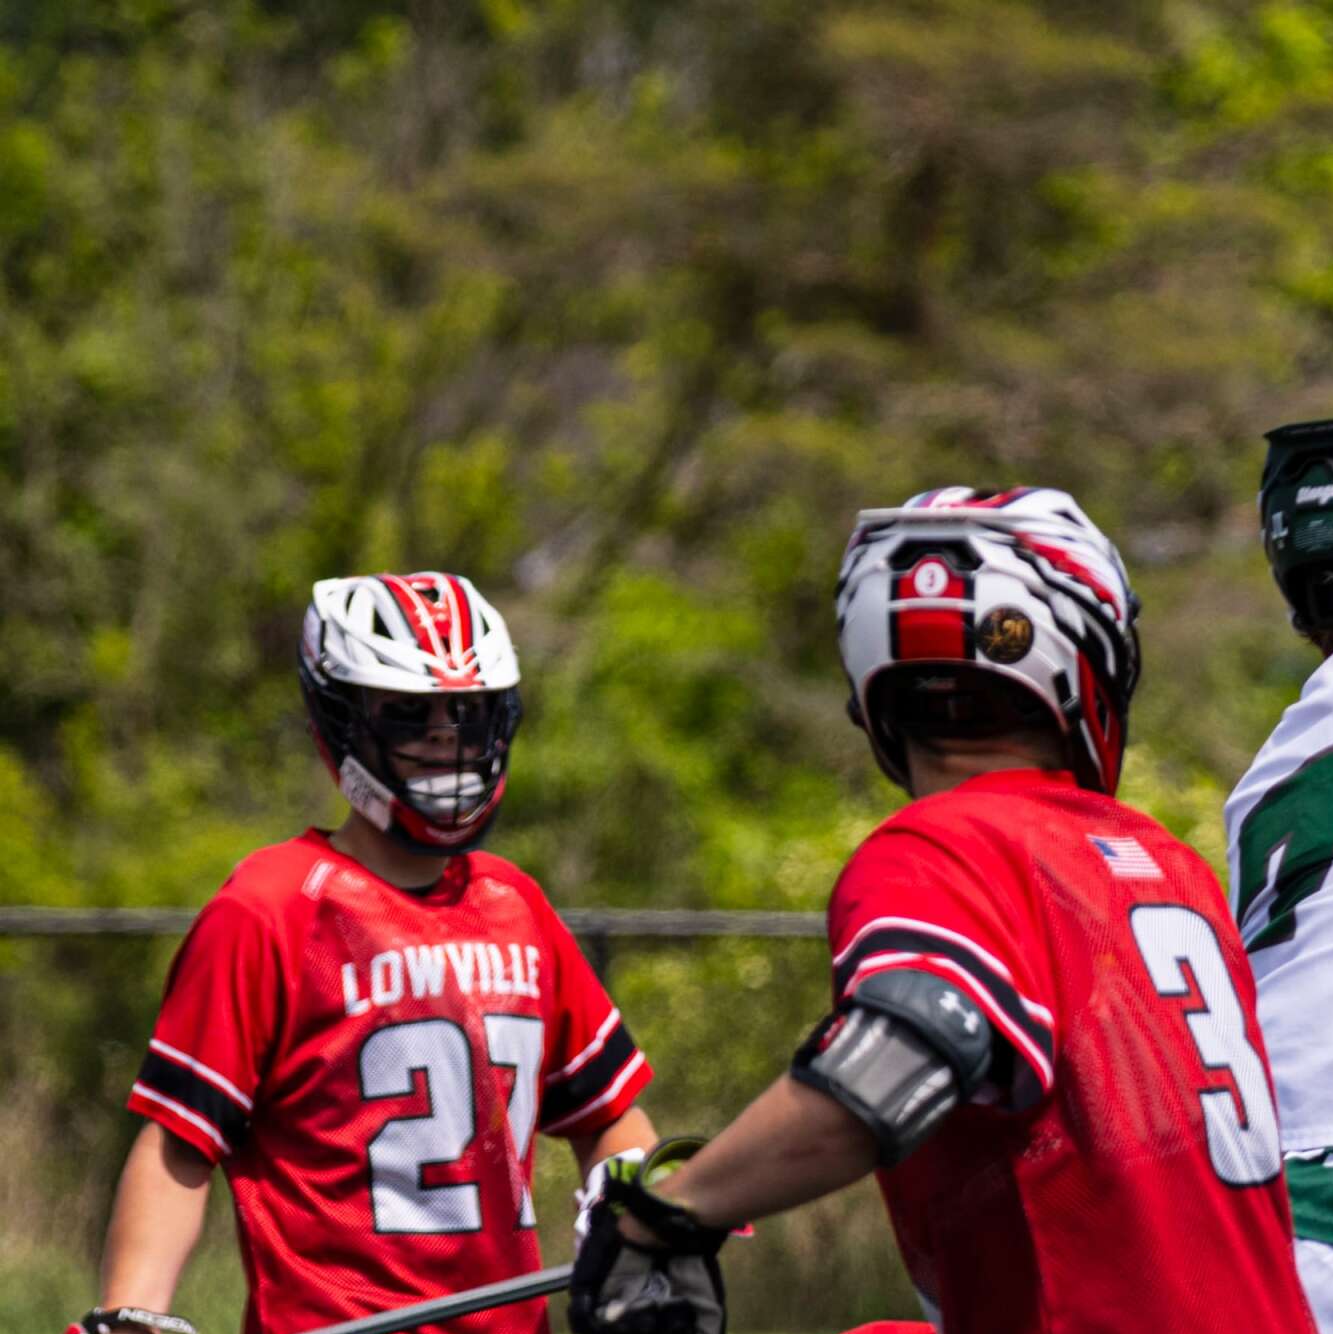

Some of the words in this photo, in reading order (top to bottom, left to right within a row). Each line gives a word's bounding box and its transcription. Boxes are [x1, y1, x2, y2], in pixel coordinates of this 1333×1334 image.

[342, 940, 541, 1017] LOWVILLE
[1129, 903, 1281, 1188] 3
[359, 1013, 545, 1235] 27
